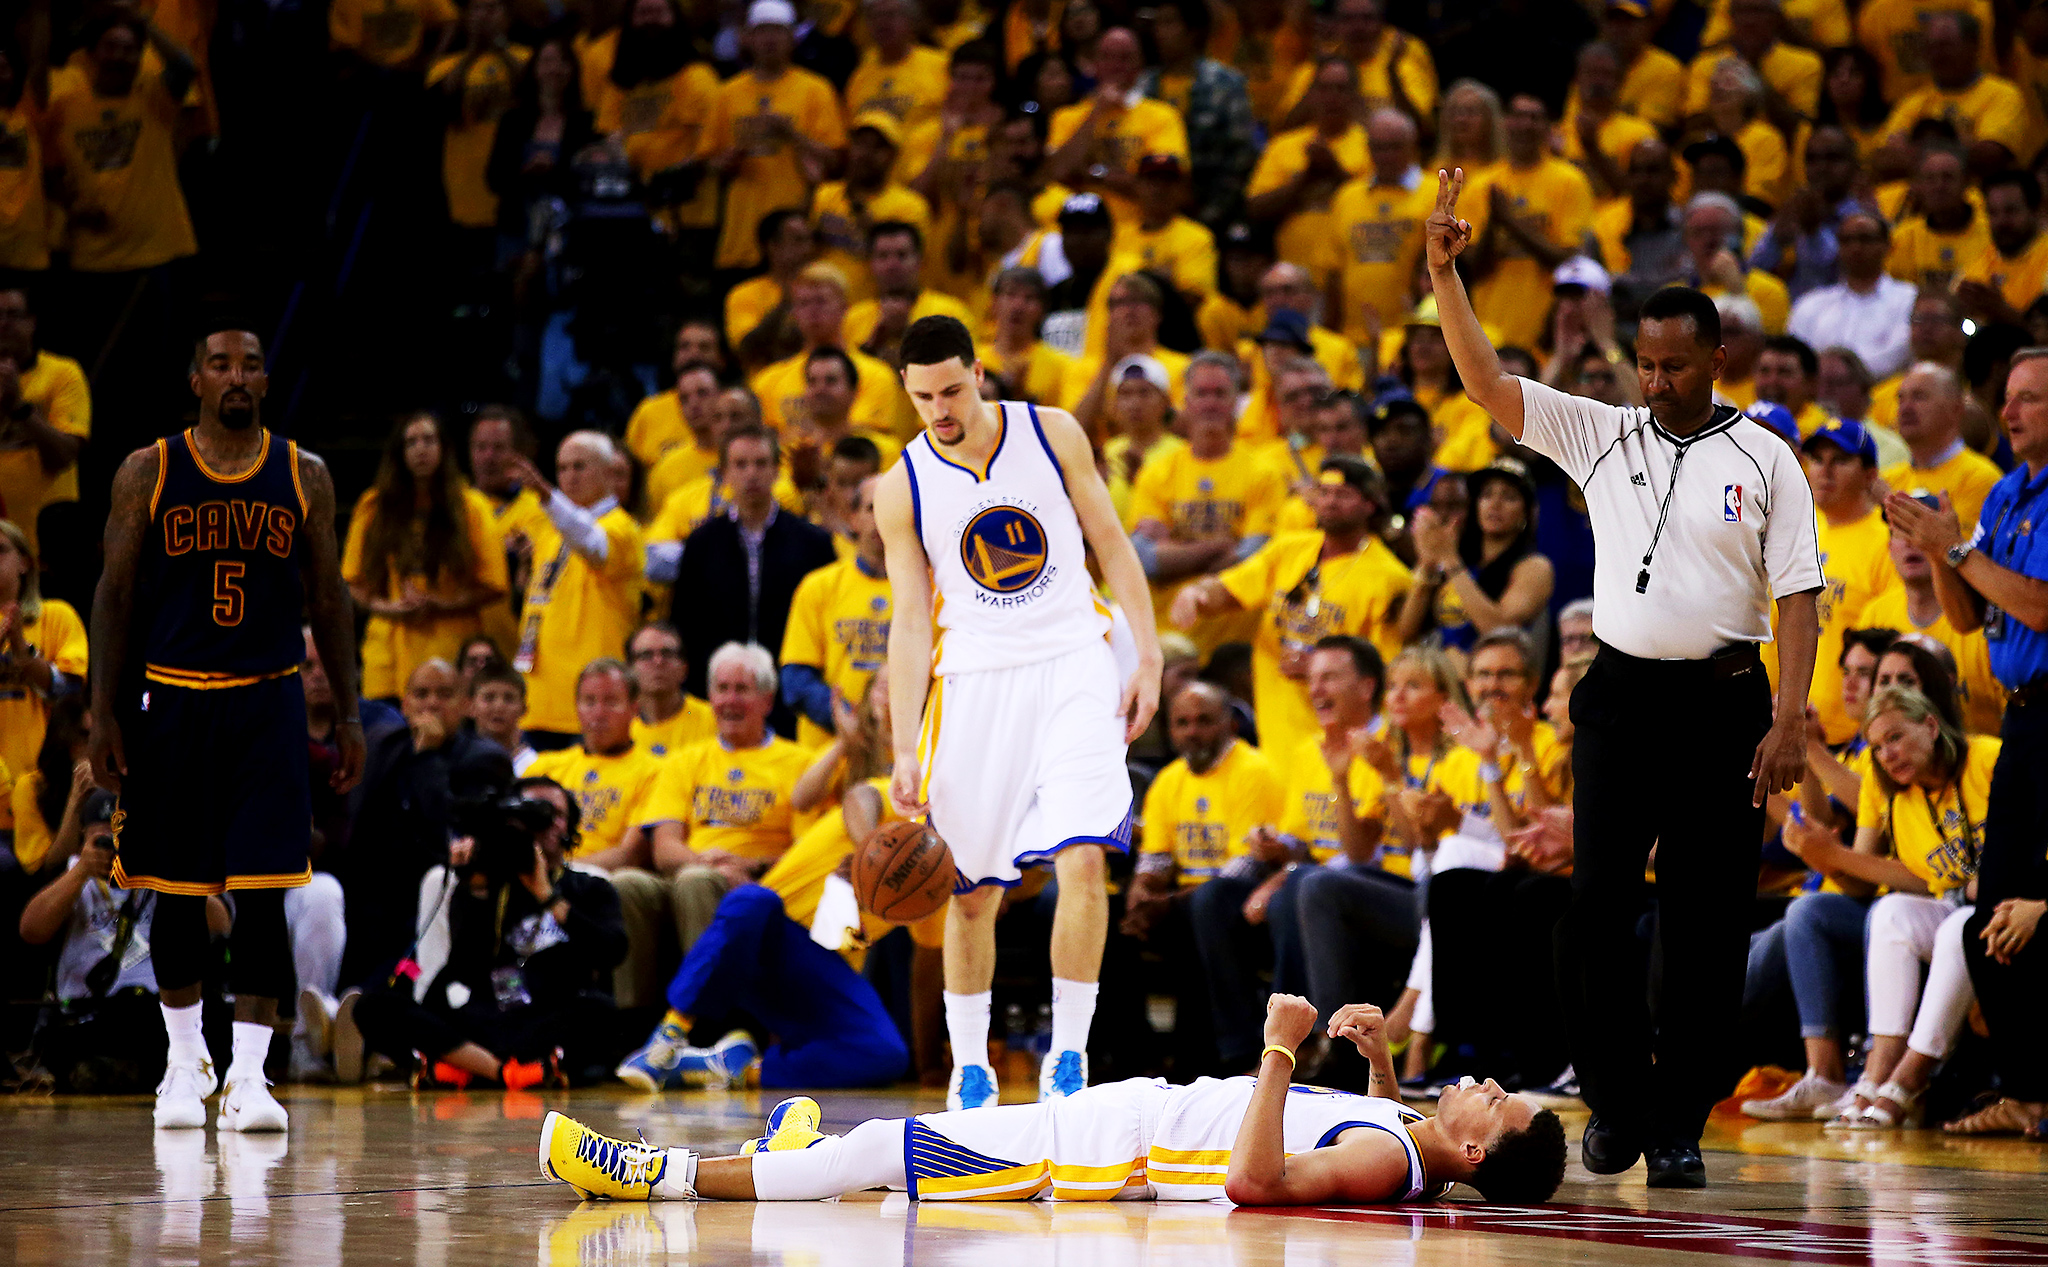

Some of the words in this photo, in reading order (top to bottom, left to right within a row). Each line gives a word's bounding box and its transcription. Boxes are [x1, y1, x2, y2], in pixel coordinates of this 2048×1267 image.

[163, 498, 296, 558] CAVS
[953, 499, 995, 538] GOLDEN
[1001, 496, 1039, 512] STATE
[1005, 519, 1026, 545] 11
[212, 559, 245, 627] 5
[975, 565, 1058, 609] WARRIORS
